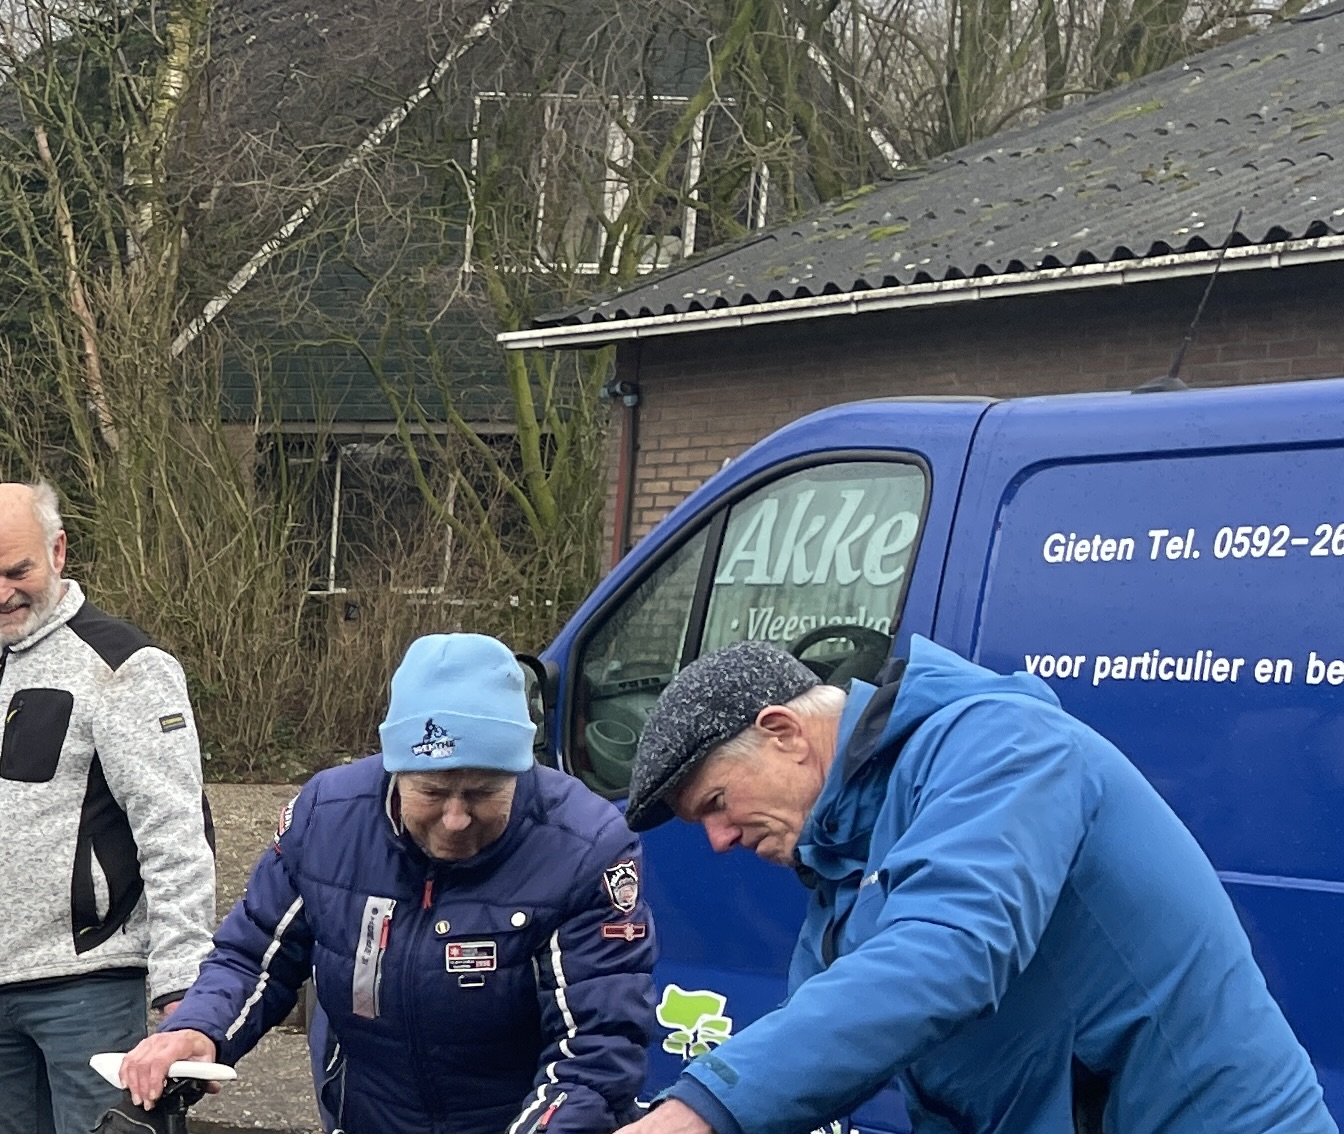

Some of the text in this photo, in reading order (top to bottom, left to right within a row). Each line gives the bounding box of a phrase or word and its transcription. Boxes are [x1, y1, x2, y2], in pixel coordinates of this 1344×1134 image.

[715, 490, 919, 585] Akke
[1043, 533, 1135, 563] Gieten
[1148, 528, 1201, 560] Tel.
[1025, 654, 1085, 678] voor
[1093, 649, 1244, 686] particulier
[1254, 658, 1293, 683] en
